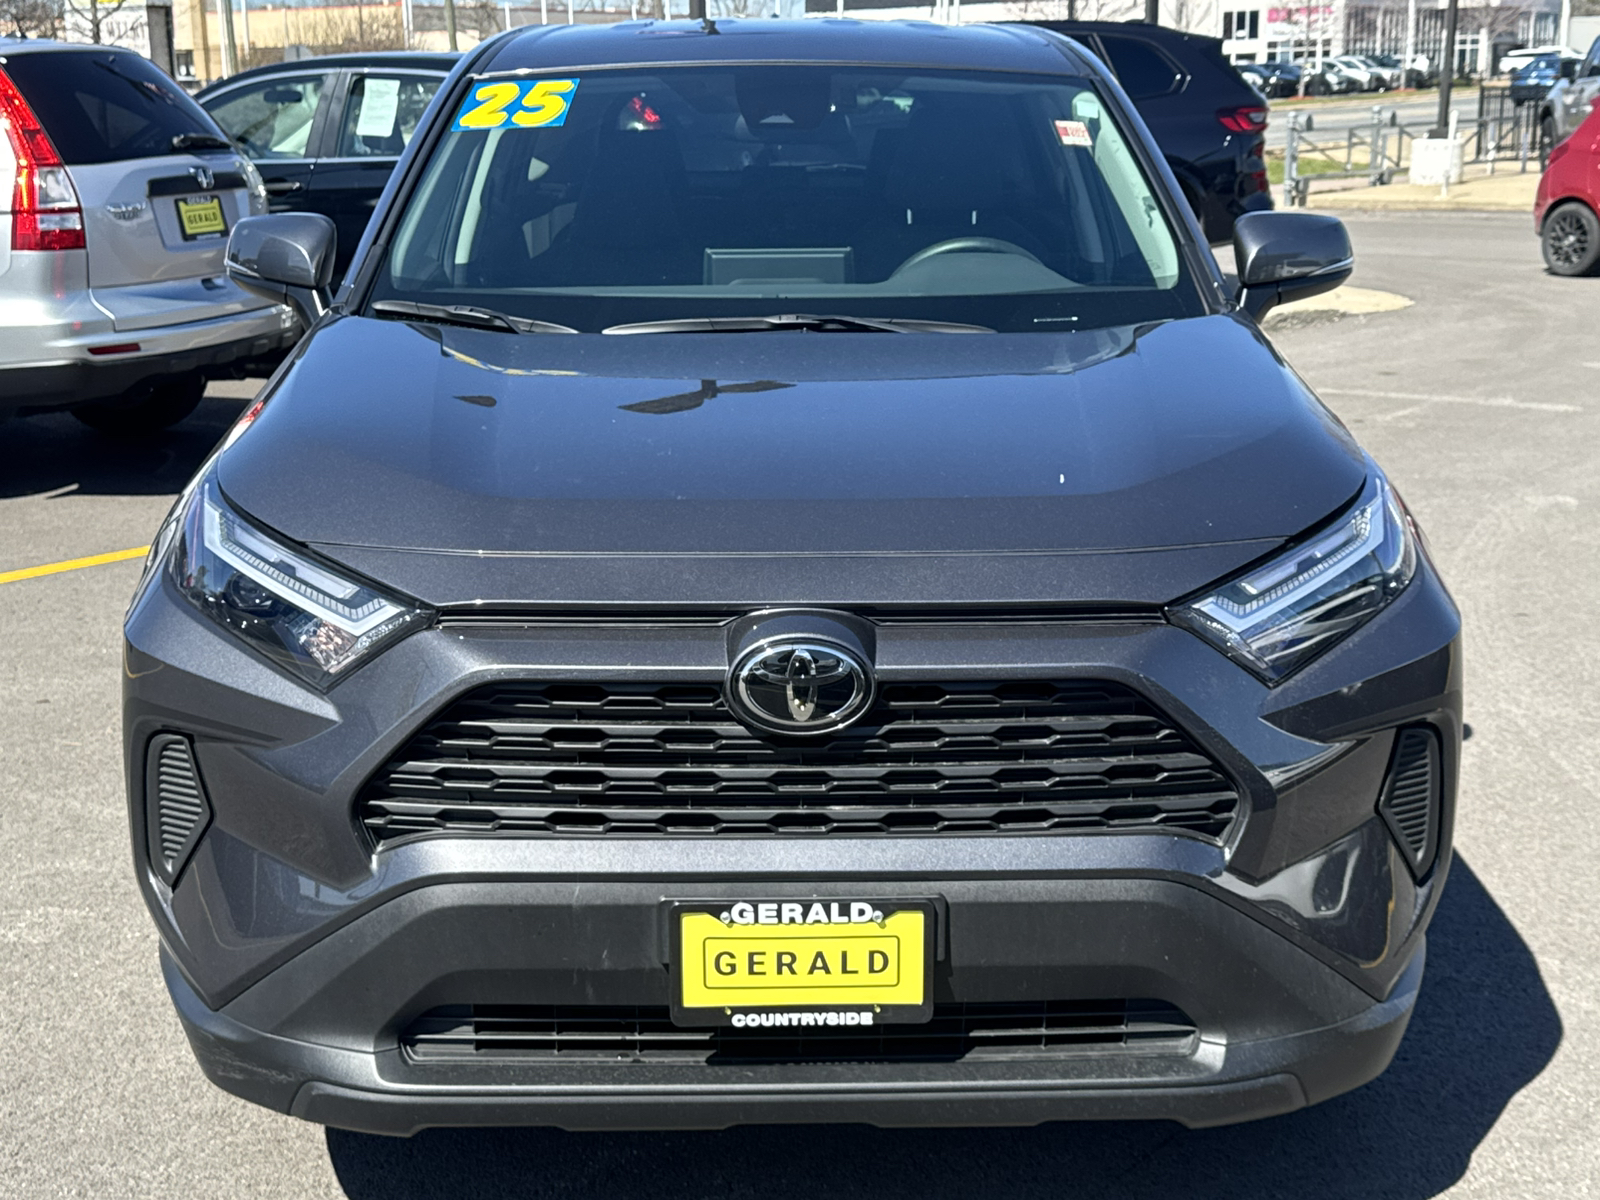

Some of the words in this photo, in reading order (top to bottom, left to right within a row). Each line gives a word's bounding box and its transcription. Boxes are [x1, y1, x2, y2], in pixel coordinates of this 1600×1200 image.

[458, 80, 575, 128] 25
[187, 211, 218, 225] GERALD
[731, 902, 873, 924] GERALD
[714, 950, 889, 975] GERALD
[731, 1012, 873, 1027] COUNTRYSIDE
